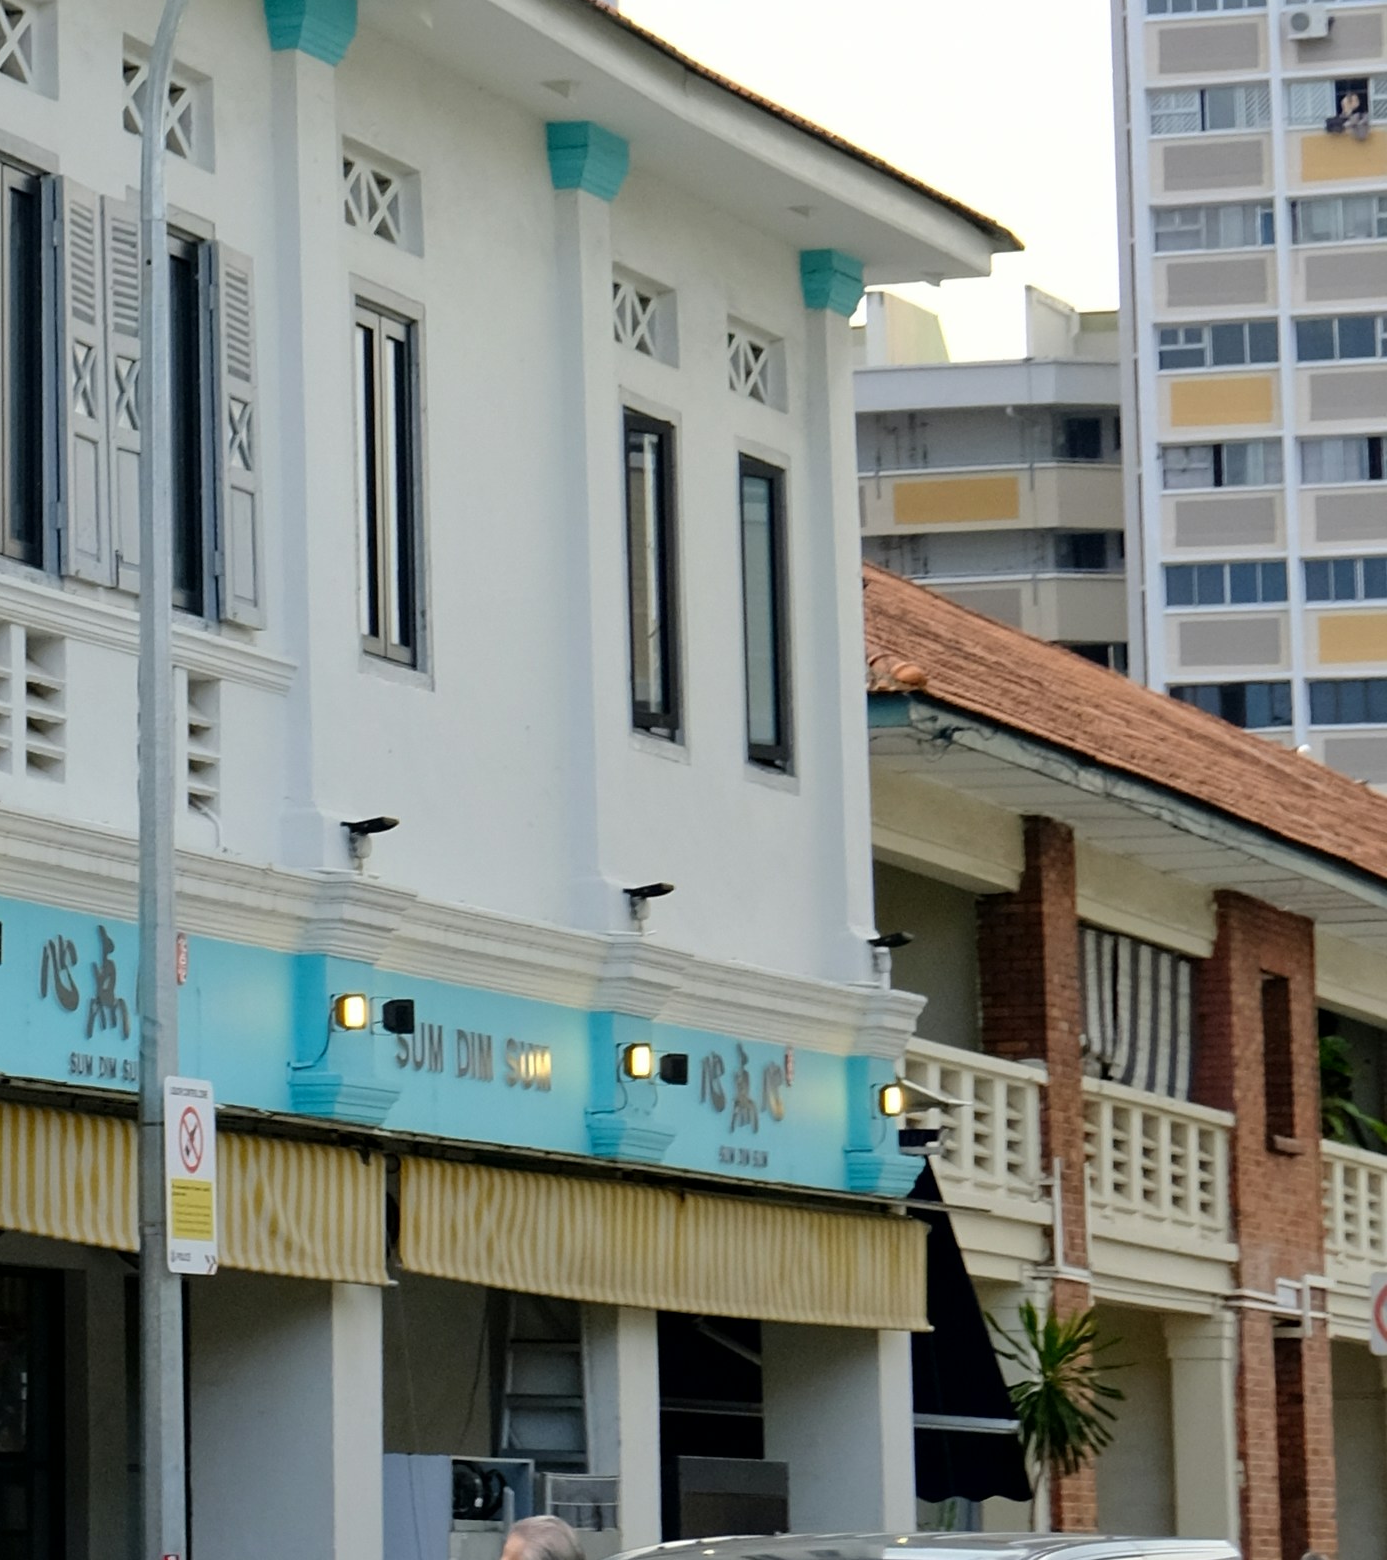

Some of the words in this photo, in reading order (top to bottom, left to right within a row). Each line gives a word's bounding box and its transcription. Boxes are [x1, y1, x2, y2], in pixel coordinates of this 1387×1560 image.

[394, 1022, 444, 1074] SUM
[455, 1027, 495, 1082] DIM
[505, 1037, 552, 1093] SUM
